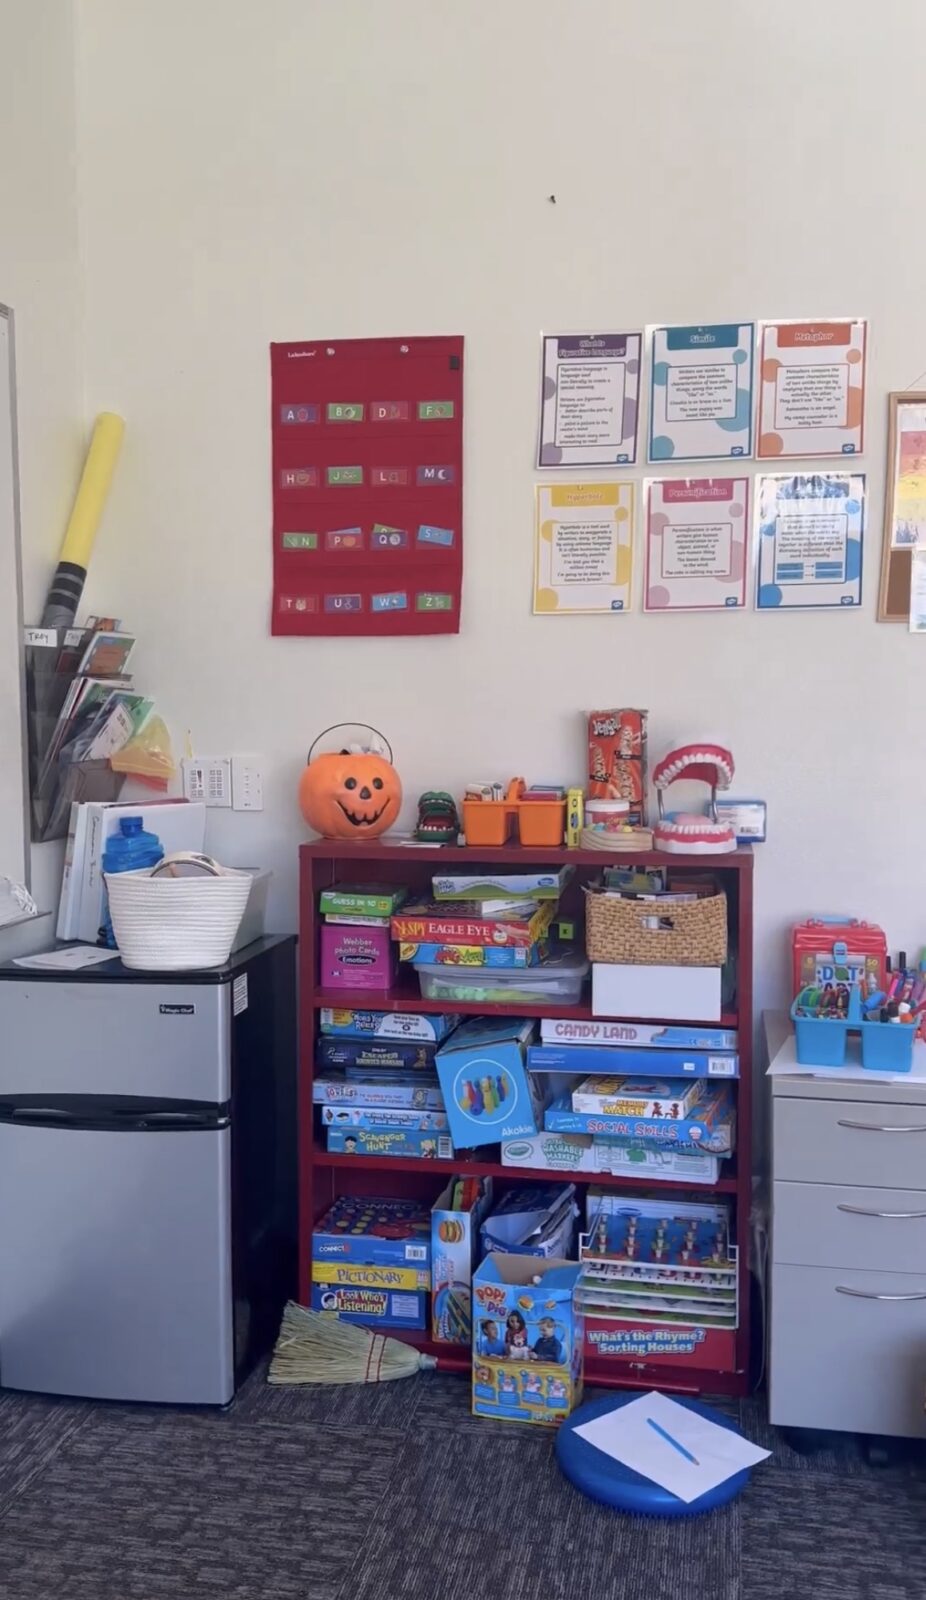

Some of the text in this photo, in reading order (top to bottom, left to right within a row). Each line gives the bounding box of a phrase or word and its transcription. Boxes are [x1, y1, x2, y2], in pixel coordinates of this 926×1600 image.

[288, 411, 294, 420] A
[336, 408, 342, 416] B
[379, 408, 386, 417] D
[426, 407, 432, 416] F
[334, 471, 340, 480] J
[380, 472, 386, 481] L
[424, 468, 434, 478] M
[287, 474, 294, 484] H
[424, 529, 430, 538] S
[302, 538, 309, 546] N
[334, 537, 340, 545] P
[379, 535, 386, 544] Q
[286, 599, 292, 608] T
[334, 598, 342, 607] U
[380, 597, 389, 606] W
[426, 598, 432, 607] Z
[593, 718, 620, 736] Jenga
[407, 921, 426, 936] SPY
[429, 922, 464, 935] EAGLE
[467, 924, 490, 936] EYE
[343, 937, 372, 946] Webber
[358, 947, 380, 955] Cards
[555, 1023, 637, 1040] CANDY LAND
[603, 1105, 645, 1116] MATCH
[502, 1125, 533, 1136] Akokie
[587, 1119, 632, 1134] SOCIAL
[635, 1122, 679, 1139] SKILLS
[367, 1142, 392, 1151] HUNT
[337, 1269, 404, 1284] PICTIONARY
[340, 1289, 384, 1301] Look Who's
[476, 1287, 506, 1304] POP!
[340, 1300, 384, 1312] Listening!
[589, 1330, 705, 1343] What's the Rhyme?
[600, 1342, 693, 1354] Sorting Houses
